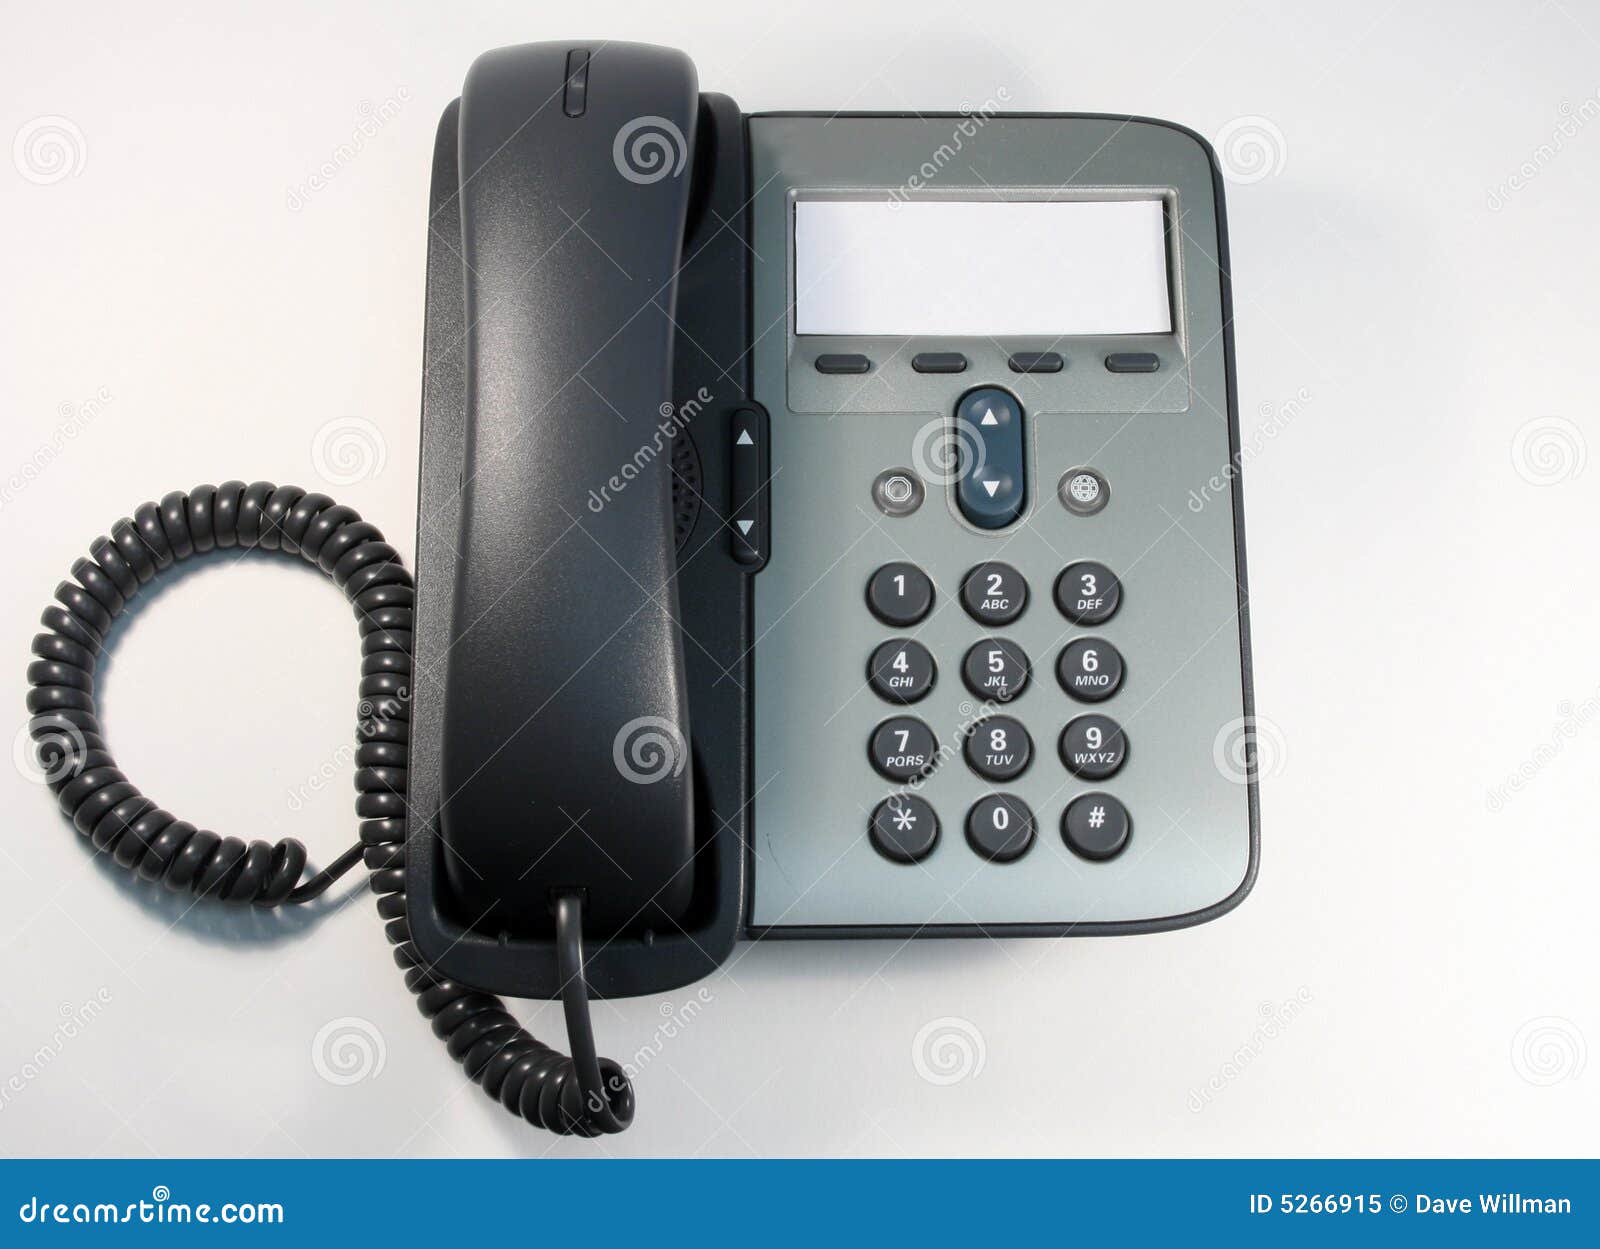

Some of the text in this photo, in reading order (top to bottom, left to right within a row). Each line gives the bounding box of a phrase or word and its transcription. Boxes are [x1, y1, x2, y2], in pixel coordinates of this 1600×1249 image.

[894, 575, 905, 596] 1
[987, 574, 1003, 596] 2
[1081, 574, 1097, 596] 3
[981, 599, 1009, 610] ABC
[1077, 599, 1103, 610] DEF
[893, 652, 909, 673] 4
[988, 651, 1004, 672] 5
[1082, 650, 1098, 672] 6
[889, 676, 913, 687] GHI
[984, 676, 1009, 687] JKL
[1075, 675, 1109, 686] MNO
[894, 730, 910, 752] 7
[990, 729, 1007, 751] 8
[1086, 727, 1102, 749] 9
[886, 755, 924, 767] PQRS
[985, 754, 1014, 765] TUV
[1075, 752, 1115, 764] WXYZ
[993, 807, 1008, 830] 0
